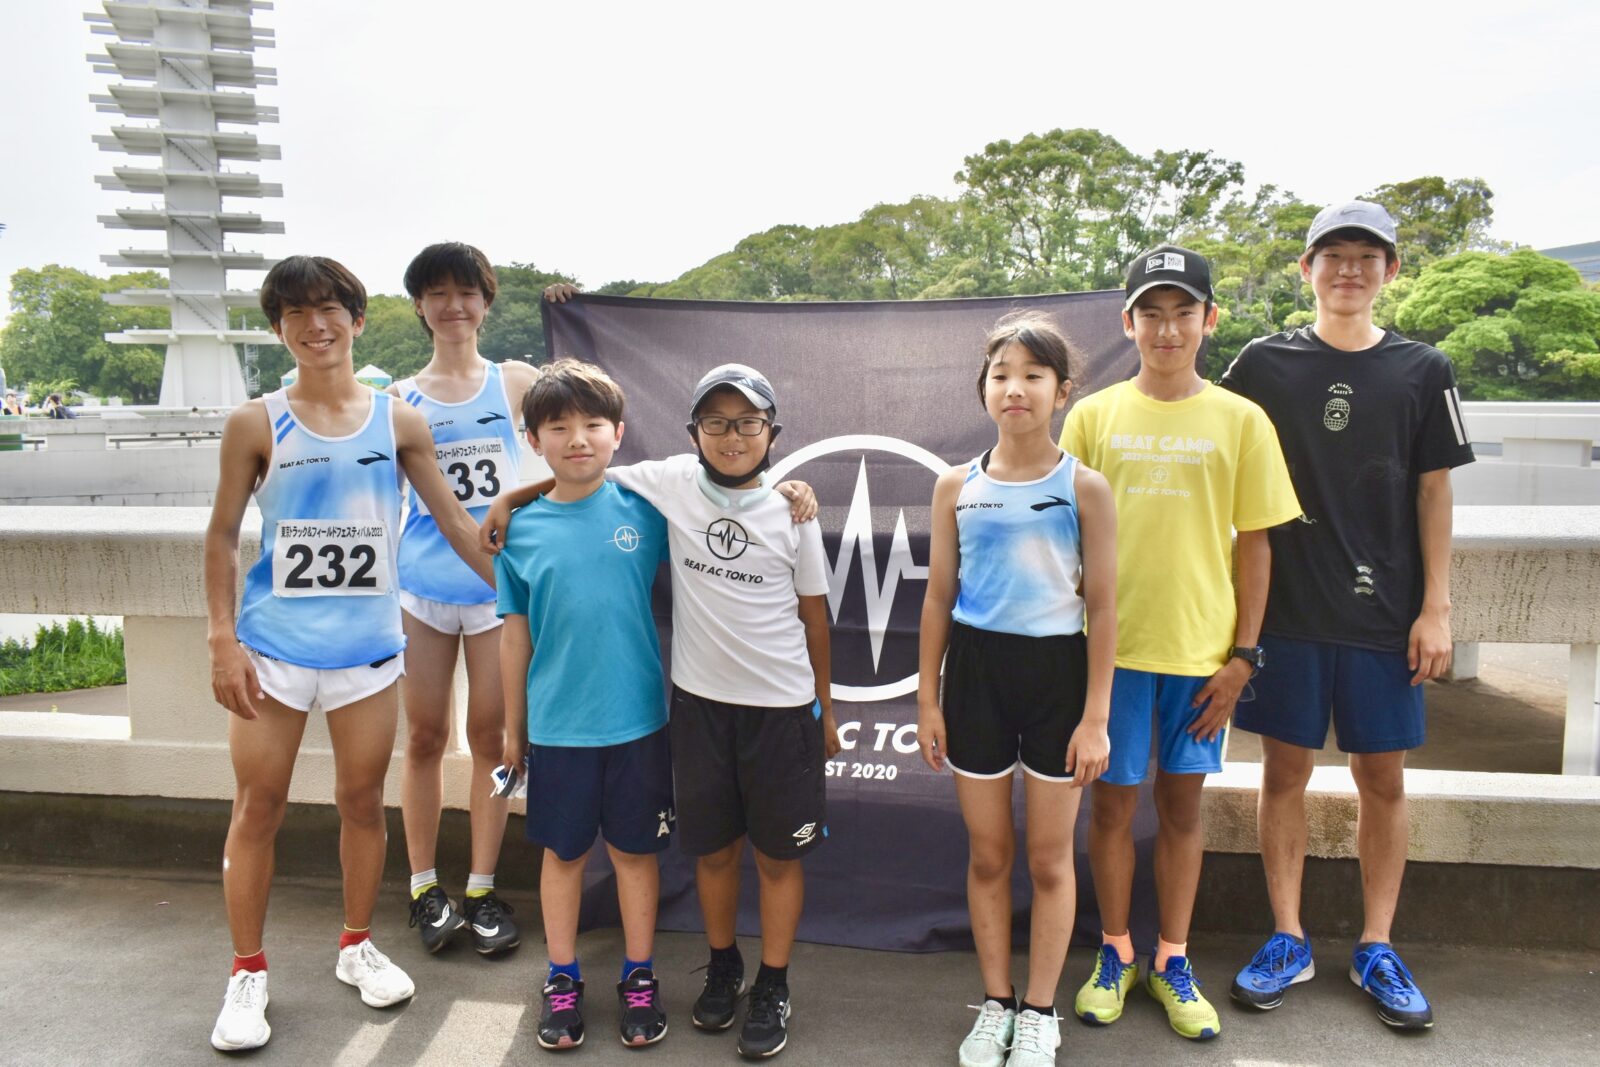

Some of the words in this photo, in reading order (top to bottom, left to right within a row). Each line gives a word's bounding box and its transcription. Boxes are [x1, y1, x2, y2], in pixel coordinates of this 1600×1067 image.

[1110, 434, 1156, 450] BEAT
[1158, 436, 1216, 454] CAMP
[280, 461, 295, 469] BEAT
[440, 458, 501, 502] 33
[956, 503, 968, 511] BEAT
[284, 543, 377, 588] 232
[684, 557, 707, 572] BEAT
[707, 566, 724, 577] AC
[725, 569, 763, 584] TOKYO
[850, 762, 898, 780] 2020
